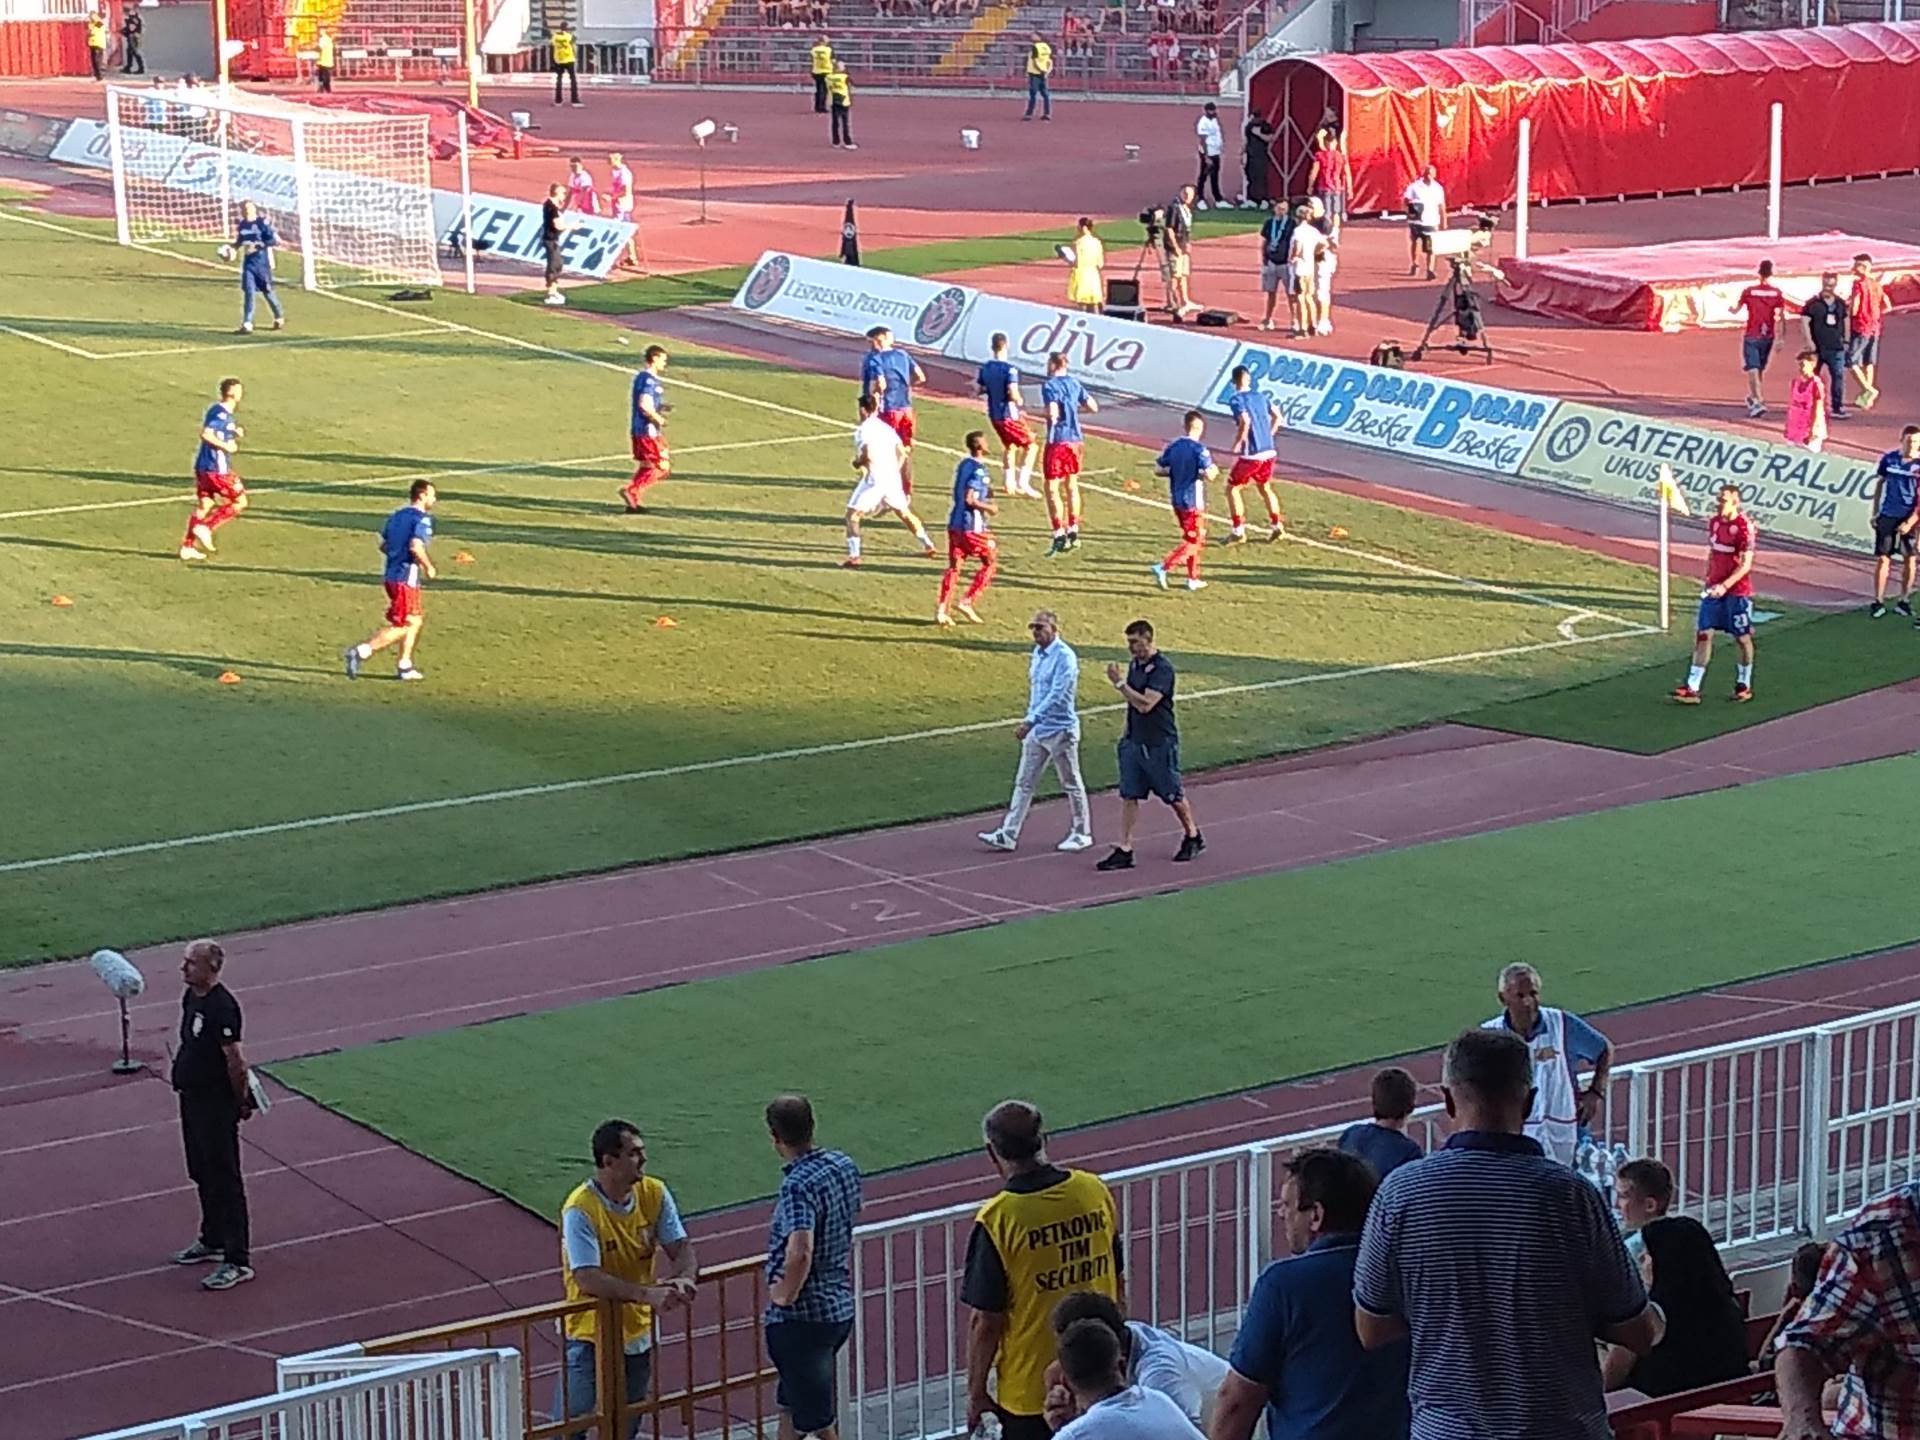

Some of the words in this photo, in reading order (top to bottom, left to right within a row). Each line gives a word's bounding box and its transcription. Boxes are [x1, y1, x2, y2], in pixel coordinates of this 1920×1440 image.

[1021, 312, 1145, 372] diva
[1311, 367, 1436, 428] BOBAR
[1413, 386, 1546, 449] BOBAR
[1345, 408, 1414, 446] Beška
[1449, 430, 1523, 469] Beška
[1597, 419, 1758, 474] CATERING
[1604, 455, 1661, 483] UKUS
[1059, 1237, 1091, 1264] TIM
